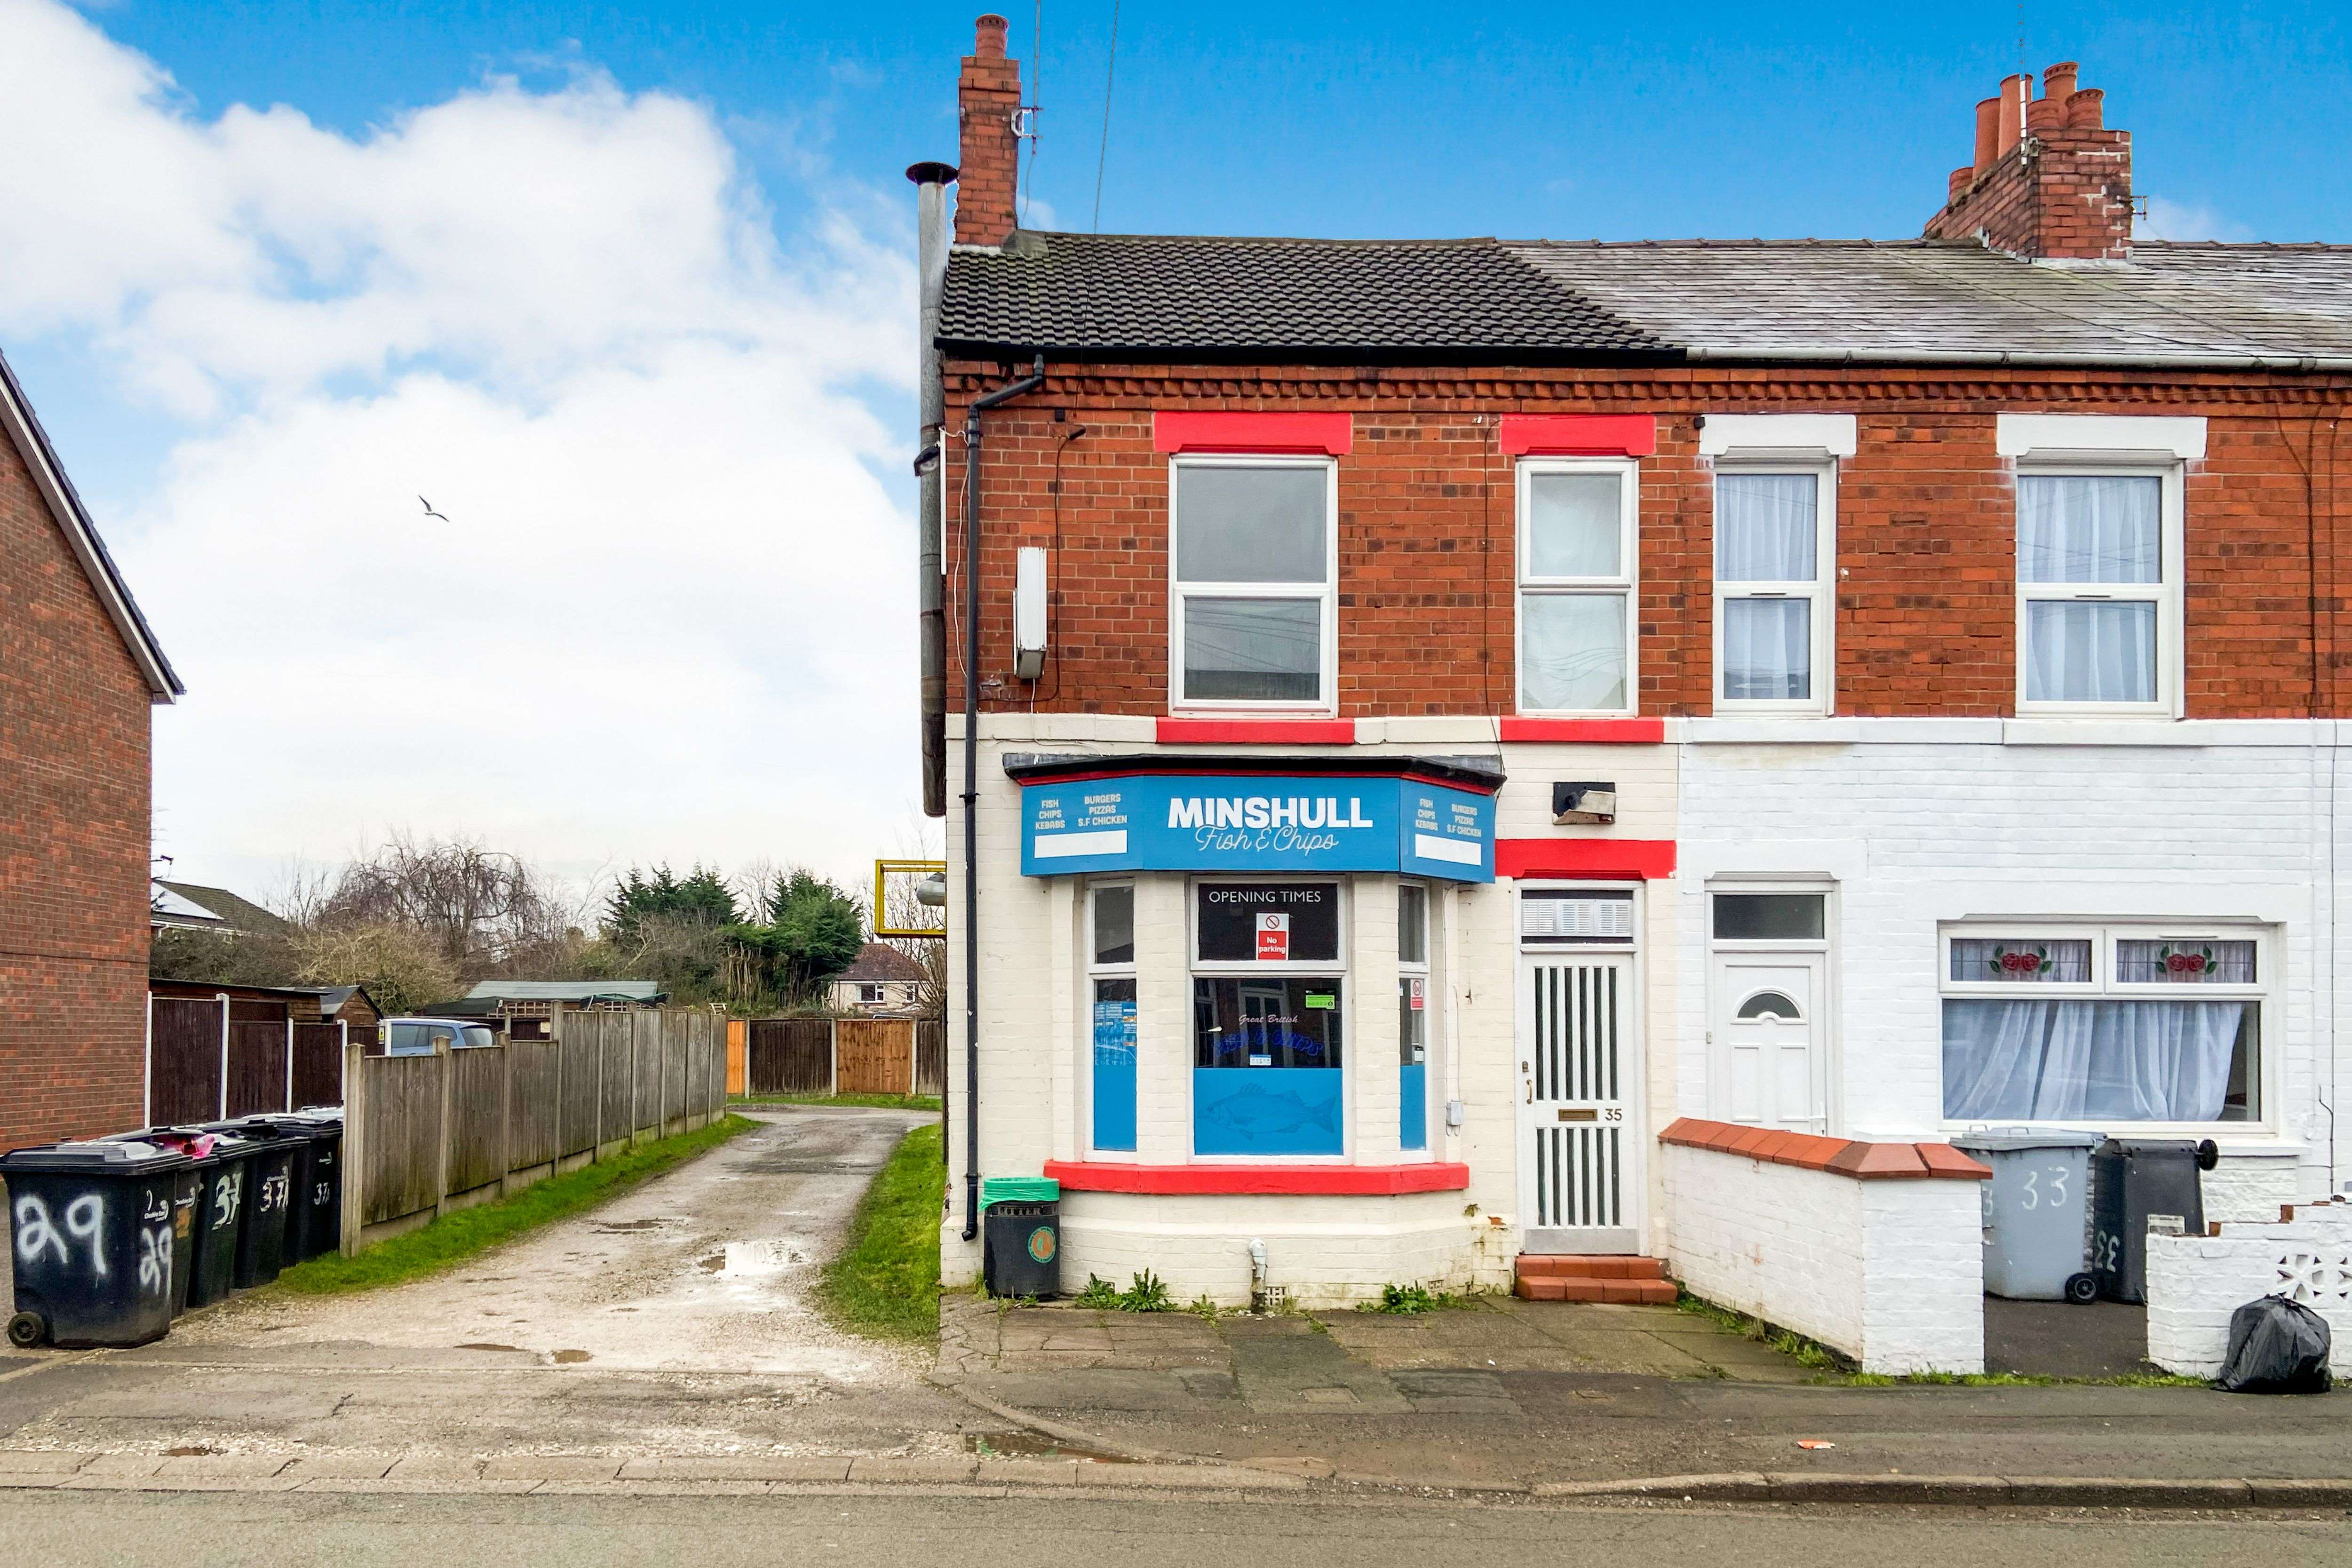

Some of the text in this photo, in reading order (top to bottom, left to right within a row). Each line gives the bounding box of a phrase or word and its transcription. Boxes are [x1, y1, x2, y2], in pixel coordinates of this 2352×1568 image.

[1041, 799, 1058, 808] FISH
[1084, 794, 1120, 804] BURGERS
[1420, 798, 1433, 808] FISH
[1039, 810, 1061, 819] CHIPS
[1089, 805, 1115, 814] PIZZAS
[1168, 797, 1373, 828] MINSHULL
[1418, 809, 1435, 819] CHIPS
[1452, 804, 1477, 815] BURGERS
[1035, 820, 1065, 829] KEBABS
[1092, 815, 1127, 825] CHICKEN
[1415, 819, 1438, 831] KEBABS
[1455, 815, 1473, 825] PIZZAS
[1457, 826, 1481, 837] CHICKEN
[1195, 824, 1339, 855] Fish & Chips
[1209, 891, 1321, 902] OPENING TIMES
[1239, 1014, 1298, 1025] Great British
[1605, 1108, 1621, 1120] 35
[2022, 1167, 2069, 1210] 33
[16, 1195, 107, 1274] 29
[140, 1226, 173, 1298] 29
